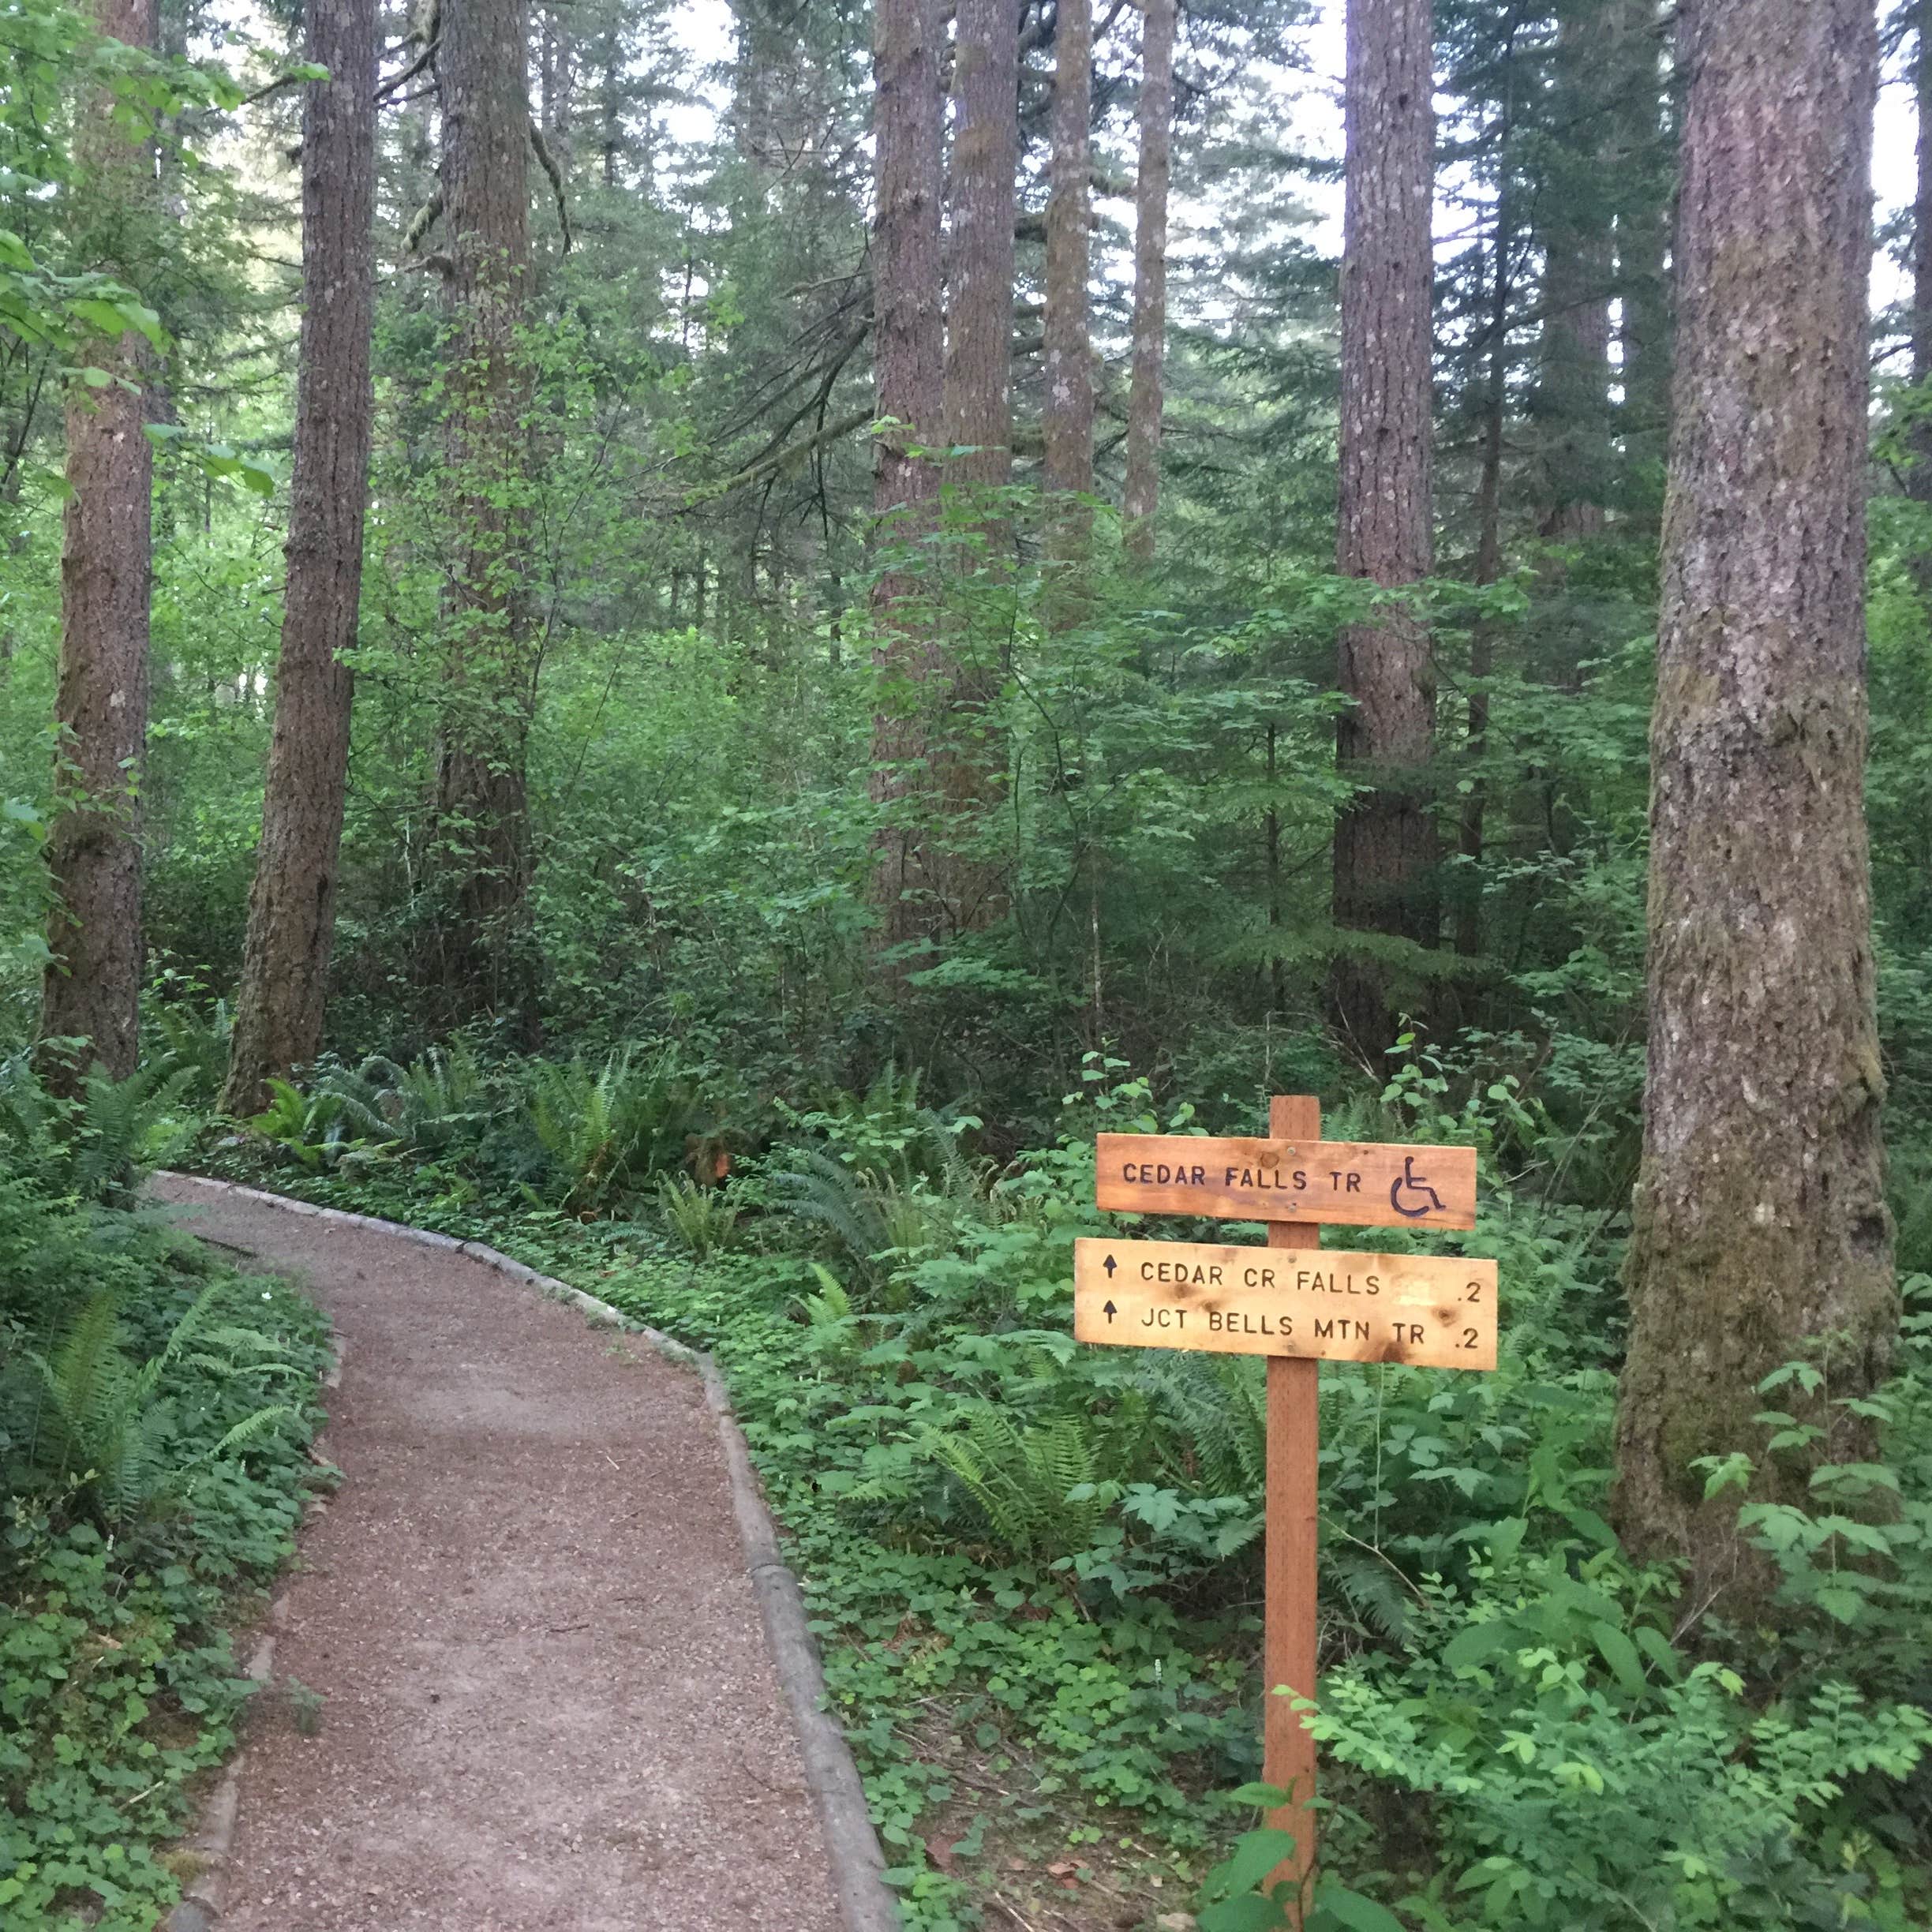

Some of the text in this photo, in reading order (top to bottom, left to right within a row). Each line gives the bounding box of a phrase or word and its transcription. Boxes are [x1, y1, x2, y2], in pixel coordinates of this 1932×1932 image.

[1122, 1163, 1361, 1193] CEDAR FALLS TR
[1140, 1262, 1481, 1302] CEDAR CR FALLS .2
[1141, 1309, 1479, 1349] JCT BELLS MTN TR .2
